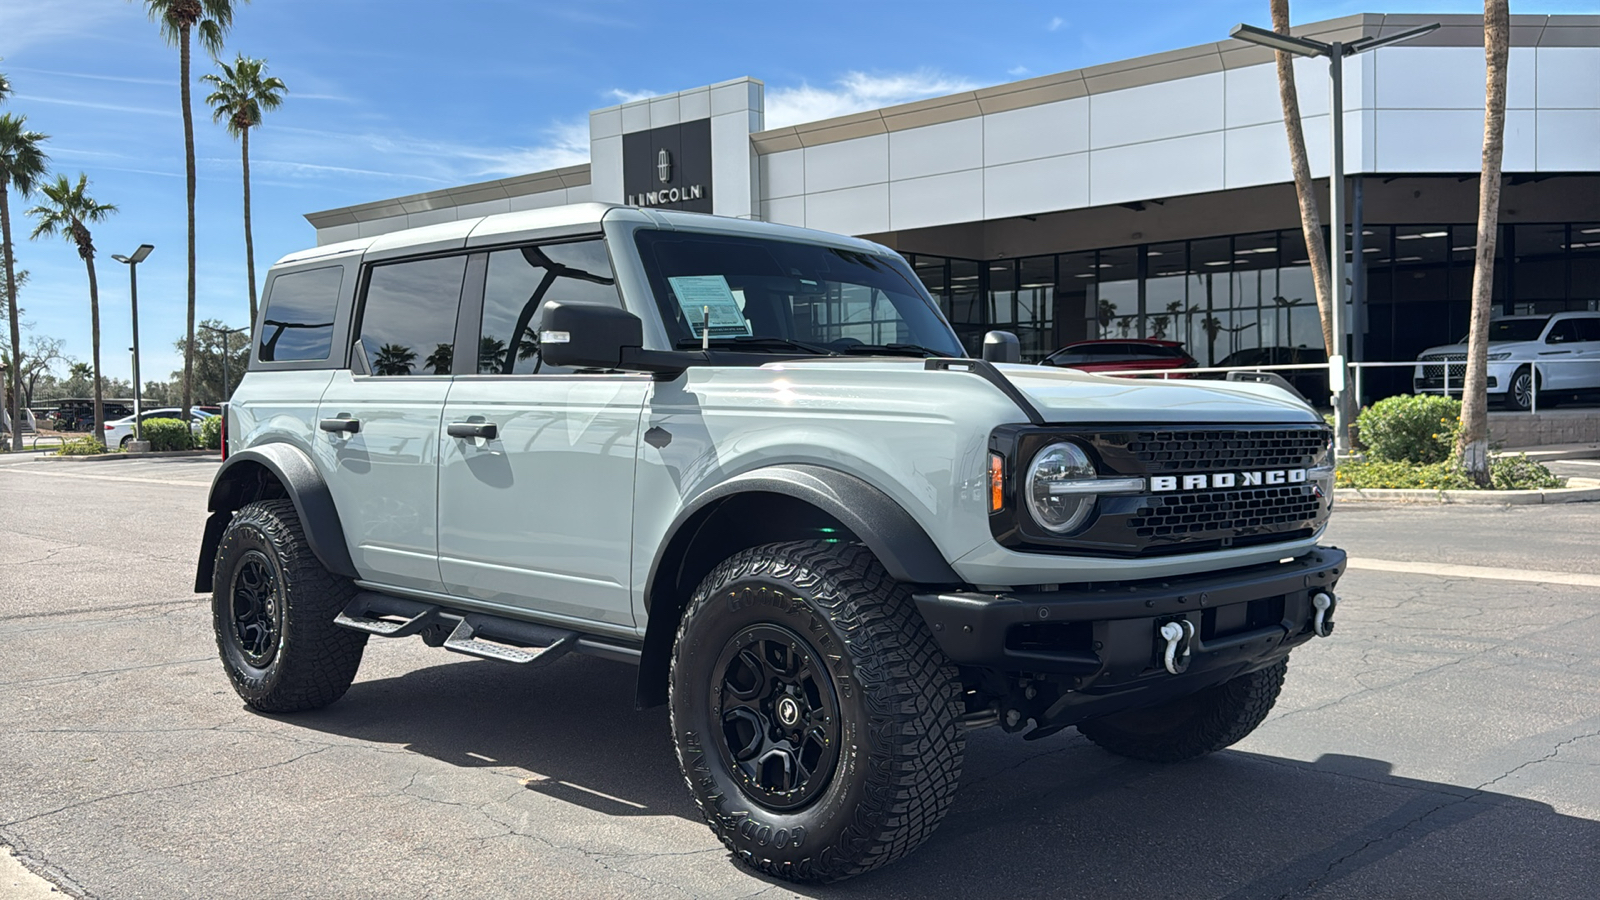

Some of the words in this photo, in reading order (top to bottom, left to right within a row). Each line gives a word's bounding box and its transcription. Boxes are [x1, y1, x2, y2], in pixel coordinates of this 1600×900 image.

[629, 184, 702, 207] LINCOLN
[1150, 468, 1306, 492] BRONCO
[727, 586, 853, 700] GOODYEAR
[684, 730, 807, 850] GOODYEAR
